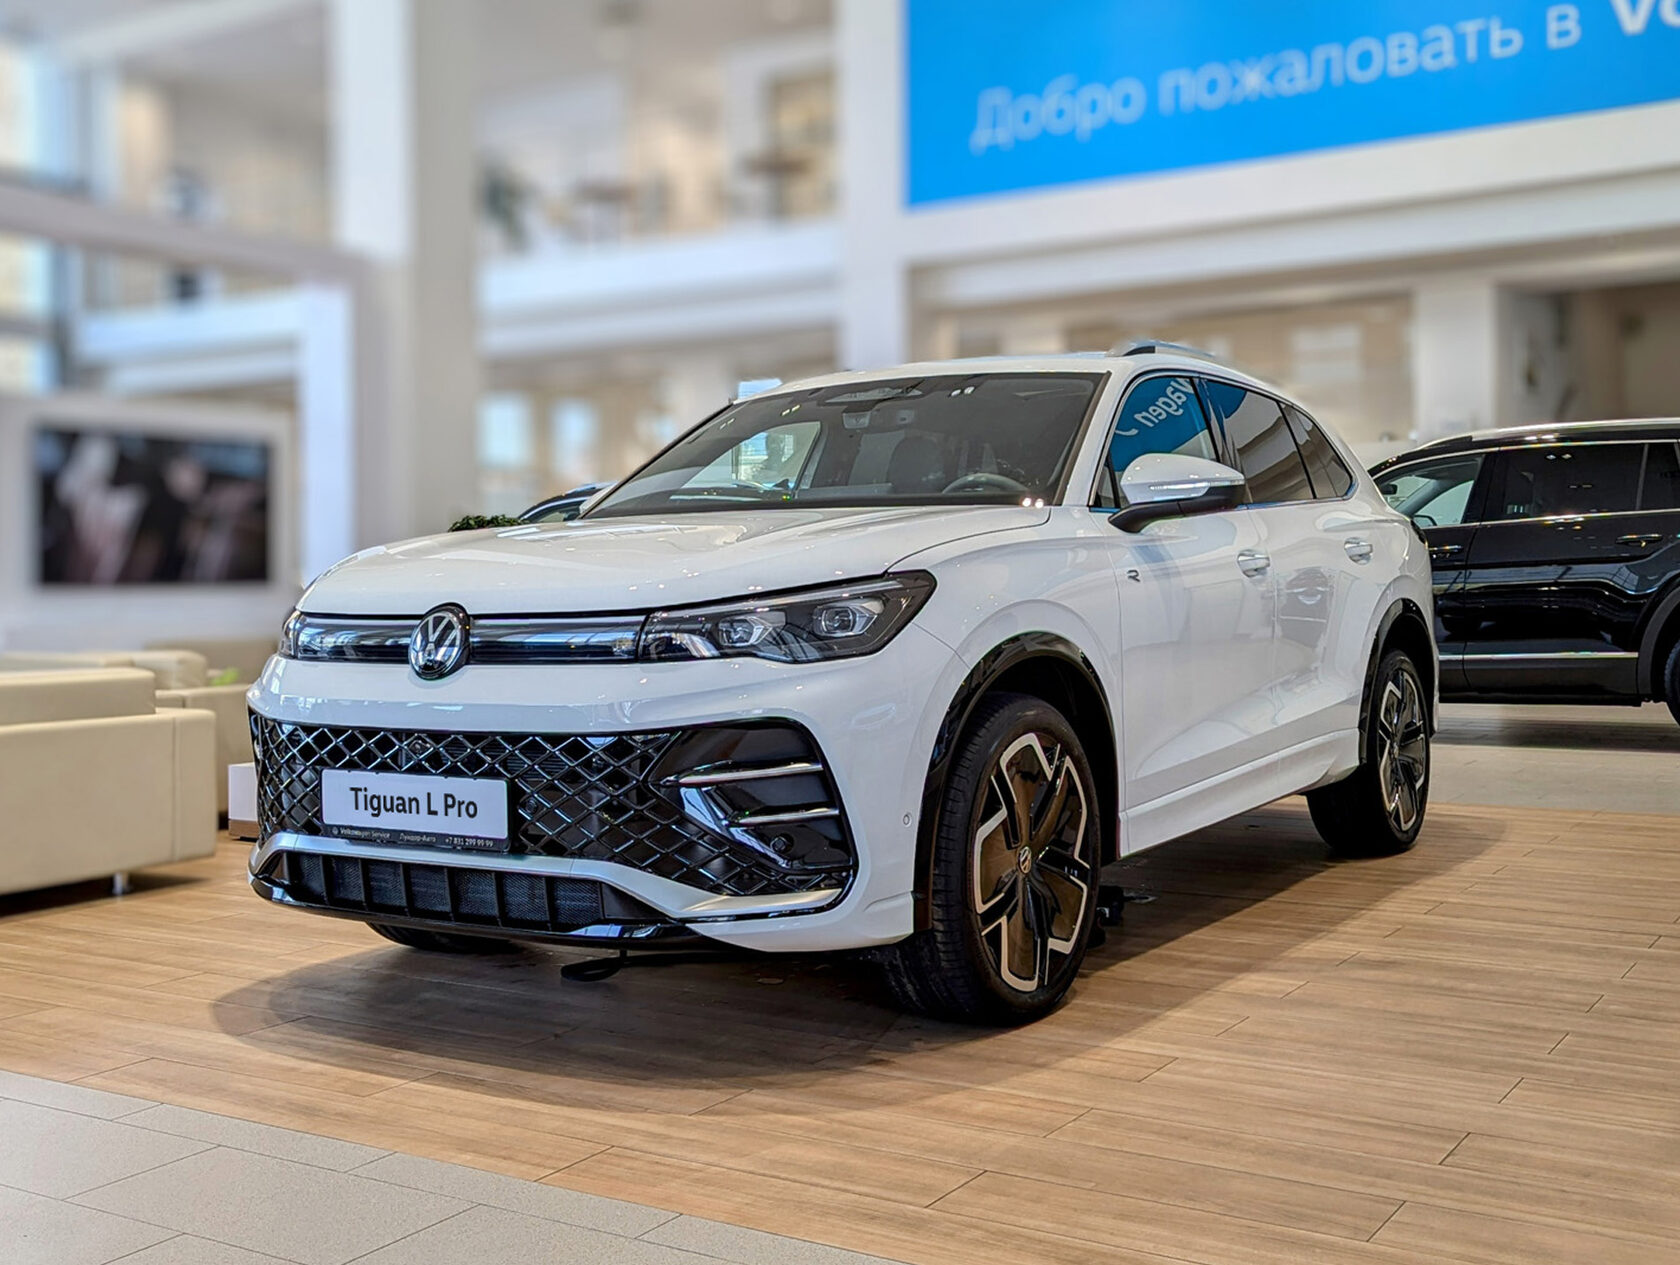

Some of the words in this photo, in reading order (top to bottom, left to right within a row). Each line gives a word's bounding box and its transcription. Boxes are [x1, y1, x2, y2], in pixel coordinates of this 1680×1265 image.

[970, 72, 1146, 156] Добро
[1158, 16, 1523, 116] пожаловать
[1546, 4, 1582, 49] в
[350, 786, 420, 818] Tiguan
[427, 792, 438, 816] L
[444, 793, 478, 819] Pro
